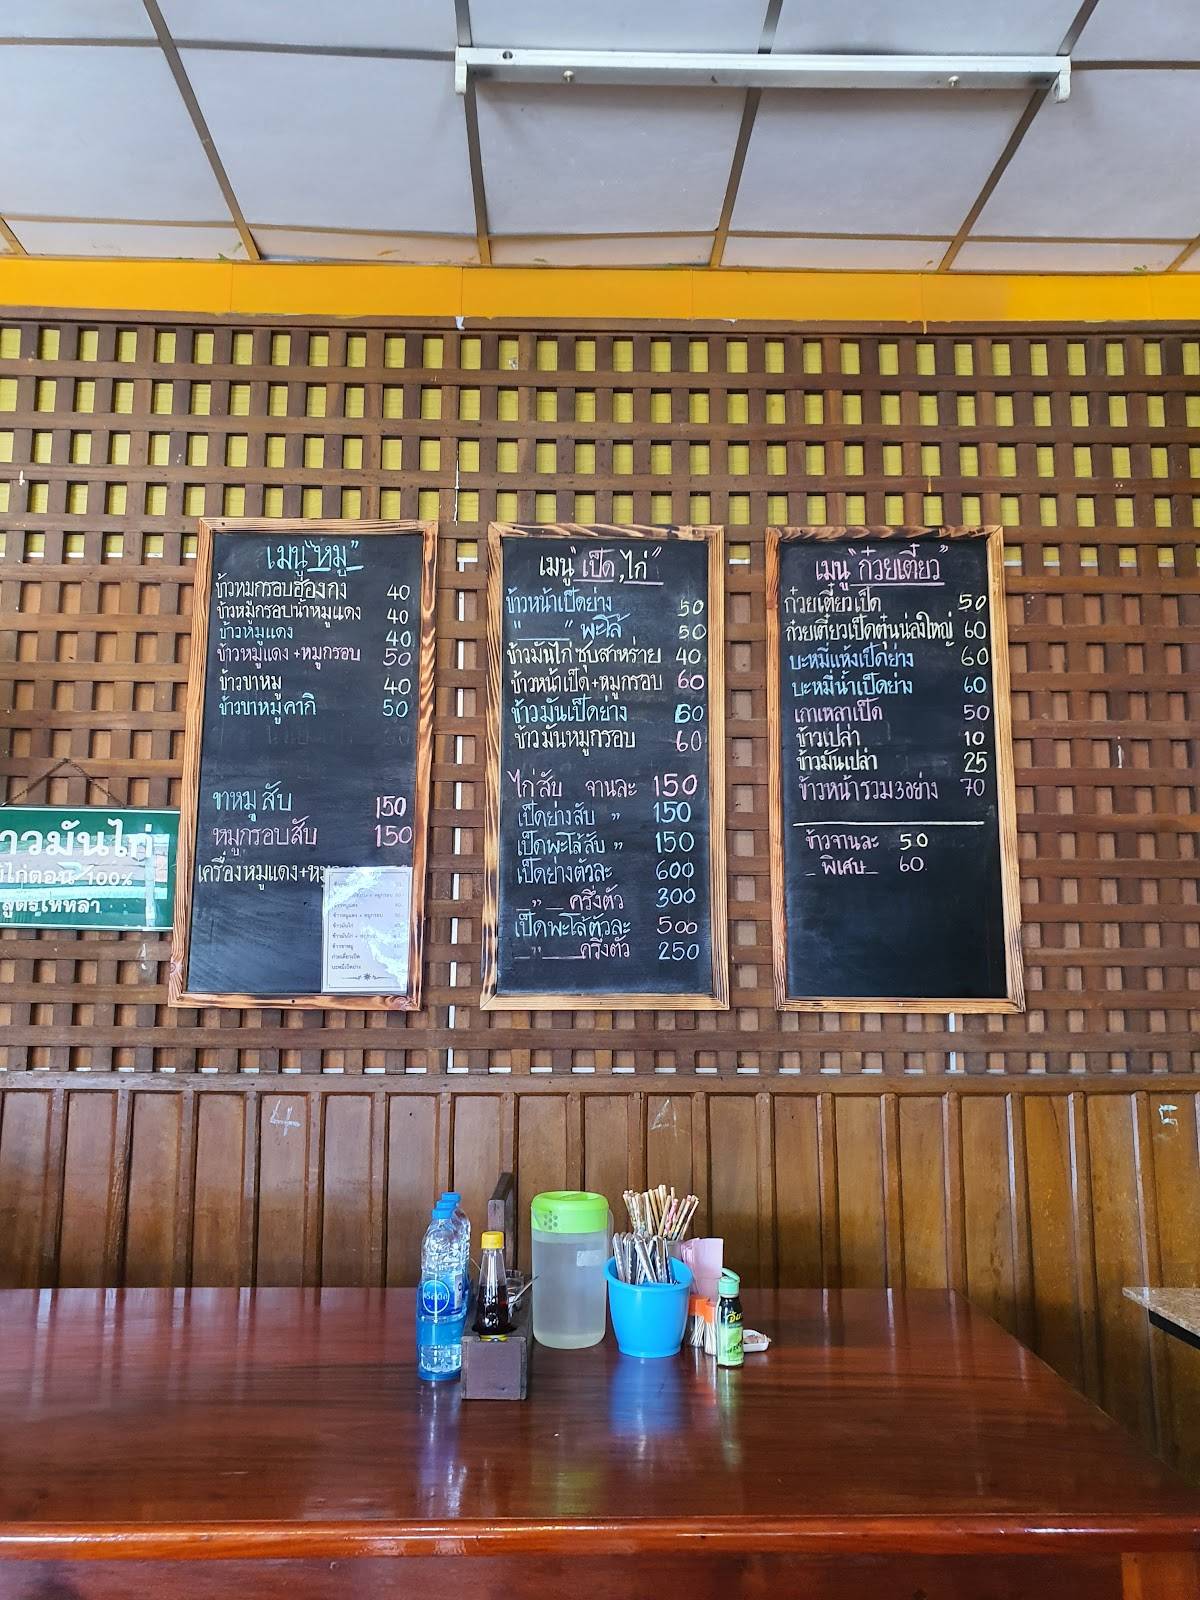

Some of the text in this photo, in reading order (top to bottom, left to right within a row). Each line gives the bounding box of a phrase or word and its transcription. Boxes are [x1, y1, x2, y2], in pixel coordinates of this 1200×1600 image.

[387, 584, 410, 600] 40
[506, 587, 704, 617] ข้าวหน้าเป็ดย่าง 50
[784, 583, 987, 613] ก๋วยเตี๋ยวเป็ด 50
[387, 608, 408, 624] 40
[219, 620, 411, 647] ข้าวหมูแดง 40
[678, 624, 706, 640] 50
[964, 621, 986, 639] 60
[383, 649, 411, 666] 50
[675, 647, 701, 665] 40
[789, 641, 989, 670] บะหมี่แห้งเป็ดย่าง 60
[219, 668, 411, 700] ข้าวขาหมู 40
[677, 669, 704, 691] 60
[792, 670, 986, 696] บะหมี่น้ำเป็ดย่าง 60
[383, 699, 408, 717] 50
[511, 694, 628, 723] ข้าวมันเป็ดย่าง
[794, 697, 990, 723] เกาเหลาเป็ด 50
[514, 723, 702, 757] ข้าวมันหมูกรอบ 60
[796, 724, 984, 748] ข้าวเปล่า 10
[796, 747, 988, 773] ข้าวมันเปล่า 25
[507, 768, 698, 798] ไก่สับ จานละ 150
[960, 778, 985, 797] 70
[376, 796, 407, 819] 150
[518, 800, 595, 827] เป็ดย่างสับ
[653, 801, 691, 824] 150
[213, 816, 412, 856] หมูกรอบสับ 150
[517, 830, 605, 856] เป็ดพะโล้สับ
[656, 831, 694, 853] 150
[805, 829, 928, 851] ข้าวจานละ 50
[87, 871, 133, 886] 100%
[517, 856, 694, 884] เป็ดย่างตัวละ 600
[656, 888, 696, 907] 300
[515, 911, 697, 937] เป็ดพะโล้ตัวละ 500
[659, 941, 699, 960] 250
